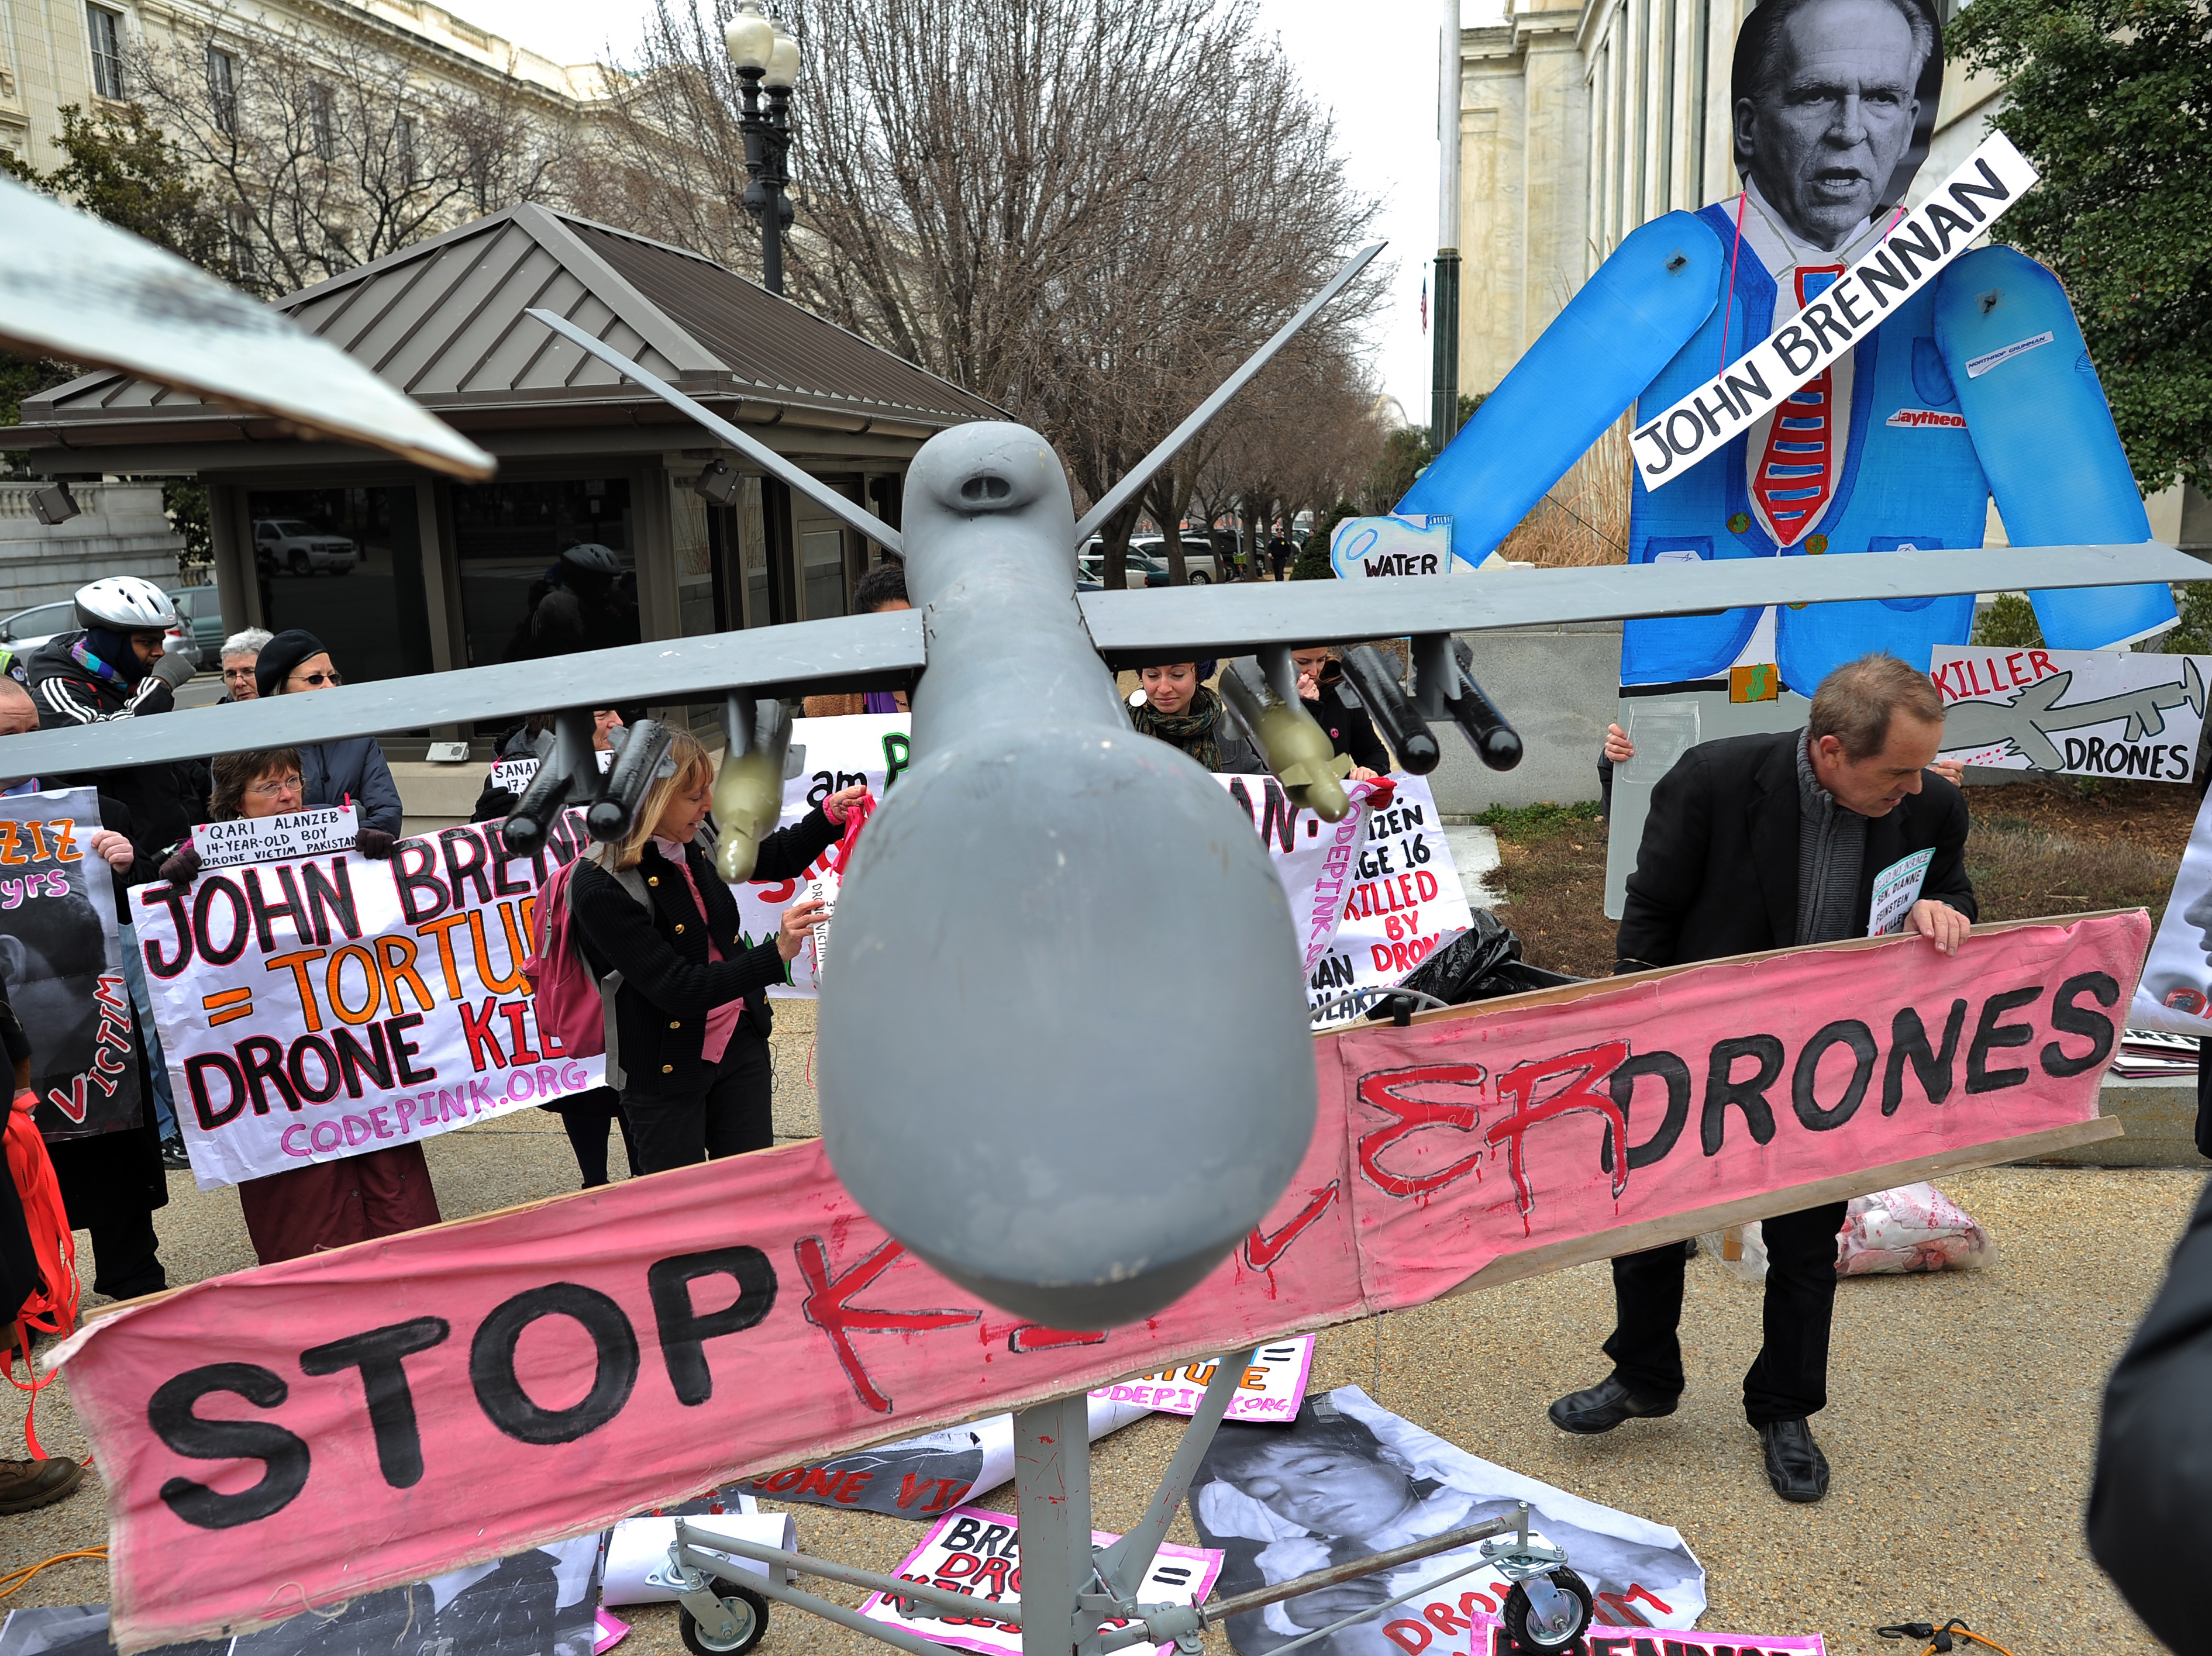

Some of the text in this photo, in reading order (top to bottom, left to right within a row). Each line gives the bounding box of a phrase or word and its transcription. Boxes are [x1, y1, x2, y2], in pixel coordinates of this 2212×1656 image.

[1635, 157, 2010, 475] JOHN BRENNAN
[1968, 336, 2045, 368] NORTHROP GRUMMAN
[1899, 411, 1966, 427] aytheo
[1363, 553, 1438, 578] WATER
[1931, 650, 2059, 702] KILLER
[2065, 737, 2188, 779] DRONES
[206, 827, 328, 855] 14-YEAR-OLD BOY
[210, 811, 339, 840] QARI ALANZEB
[203, 834, 357, 867] DRONE VICTIM PAKISTAN
[1355, 846, 1394, 881] GE
[1401, 833, 1431, 868] 16
[1, 869, 70, 909] yrs
[1343, 870, 1438, 921] KILLED
[1877, 870, 1922, 906] SEN. DIANNE
[142, 855, 363, 979] JOHN
[1384, 910, 1418, 941] BY
[1875, 892, 1910, 926] FEINSTEIN
[1311, 954, 1355, 990] AN
[48, 974, 132, 1123] VICTIM
[183, 1012, 437, 1131] DRONE
[281, 1061, 588, 1157] CODEPINK.ORG
[147, 1245, 778, 1531] STOP
[1600, 971, 2121, 1174] DRONES
